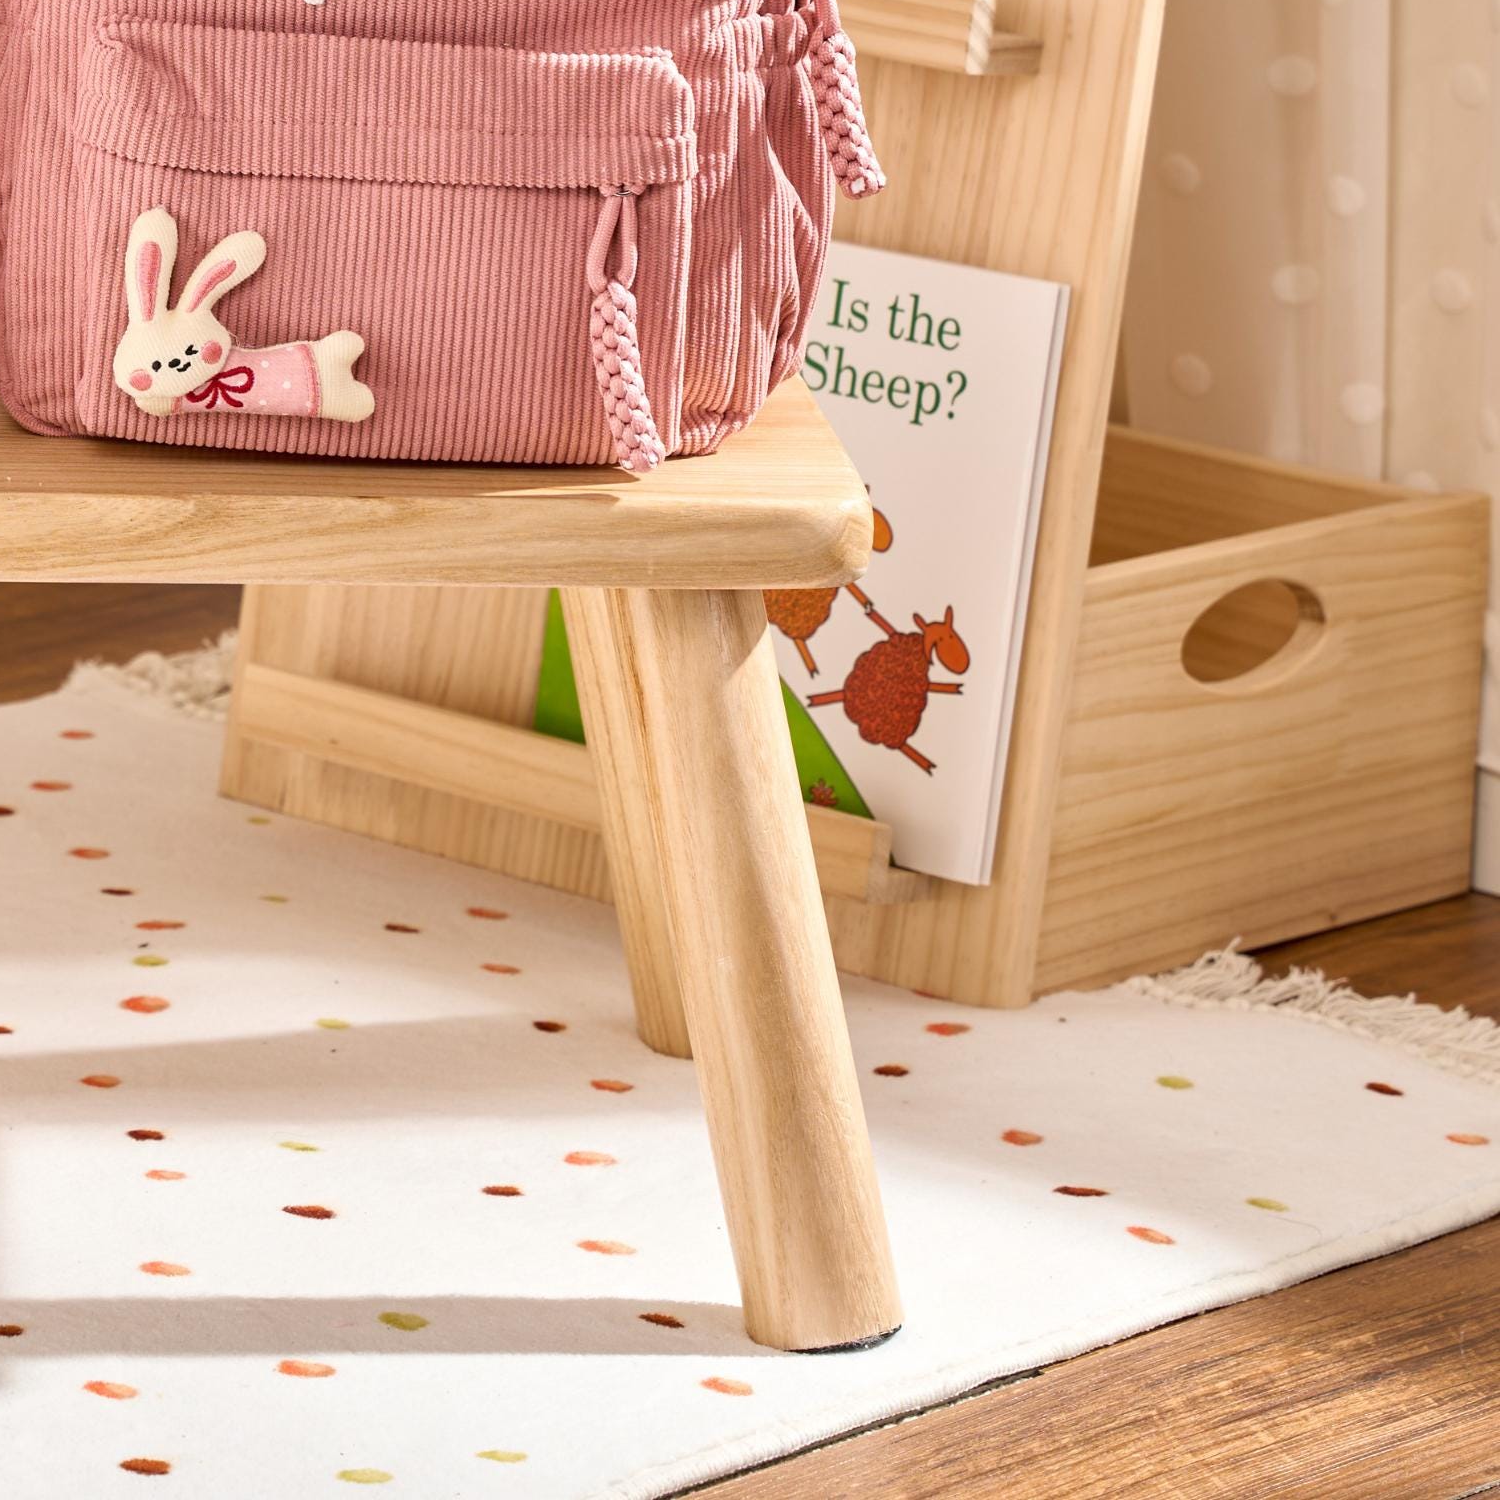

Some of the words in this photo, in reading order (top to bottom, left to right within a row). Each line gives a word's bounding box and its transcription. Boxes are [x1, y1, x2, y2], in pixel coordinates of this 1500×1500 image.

[827, 278, 869, 333] Is
[887, 293, 961, 351] the
[800, 341, 968, 426] Sheep?
